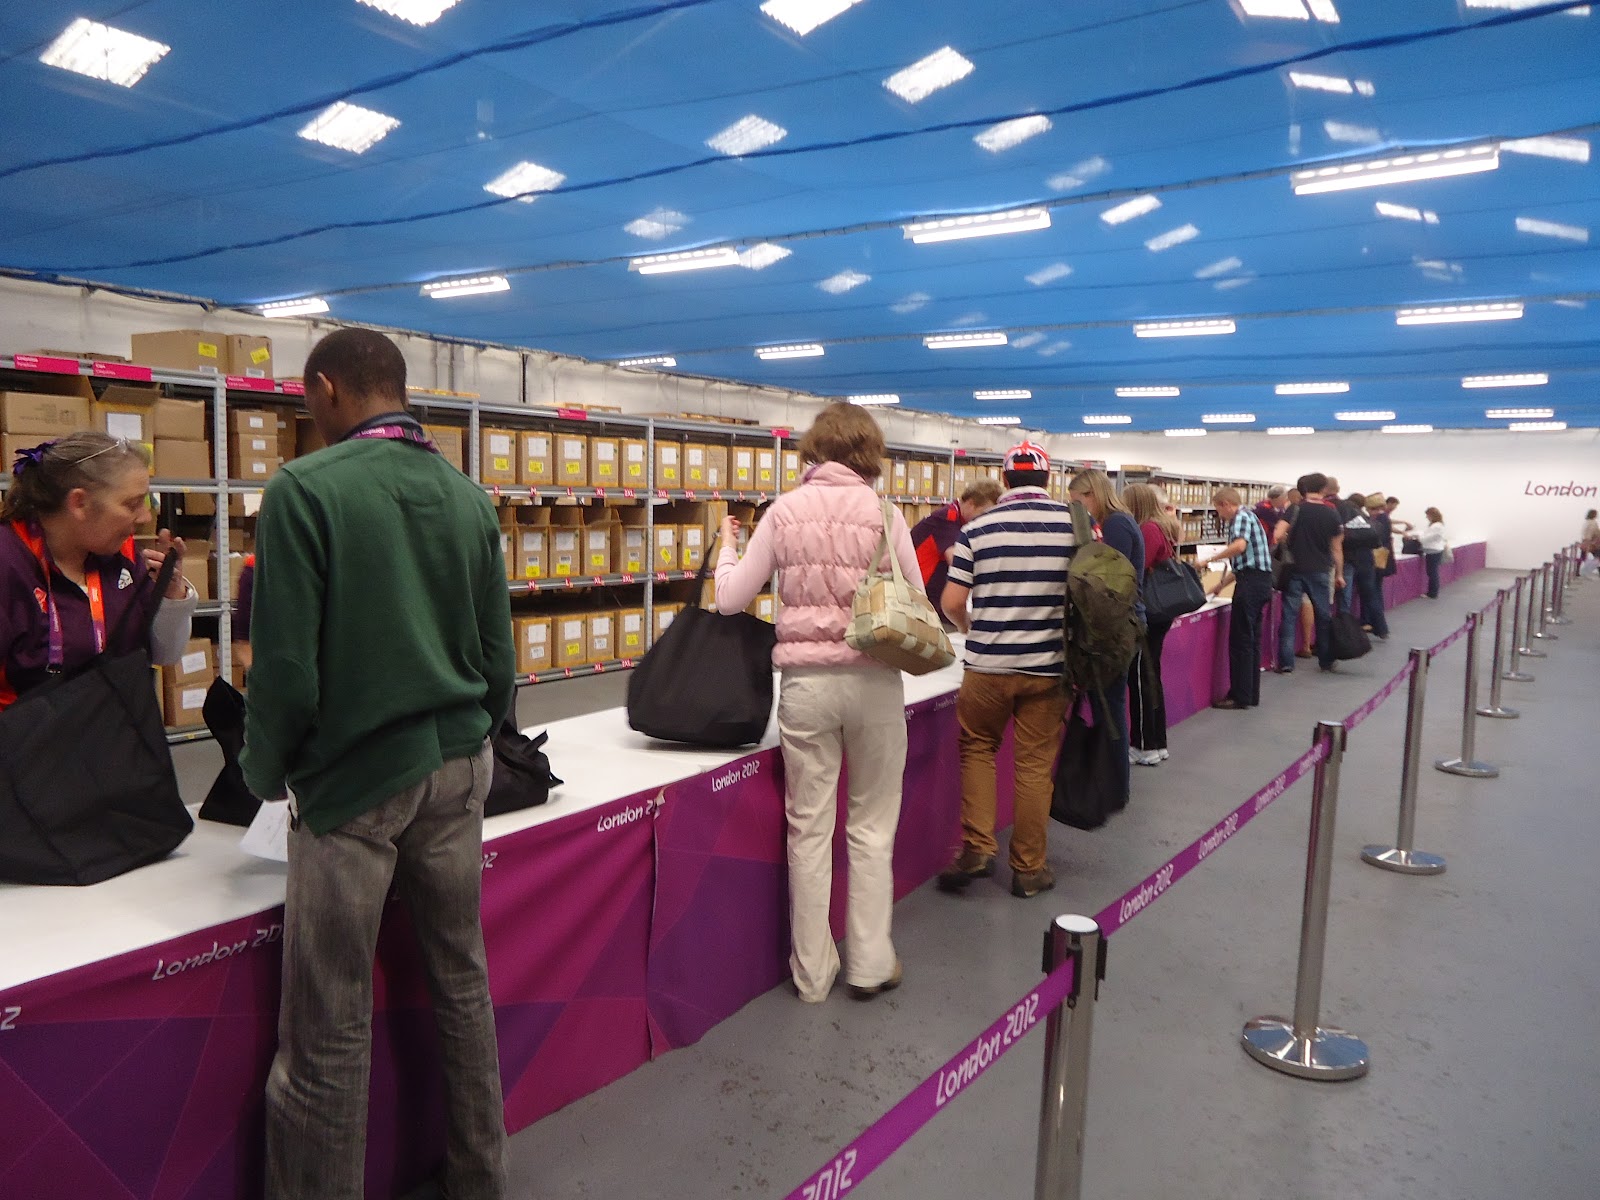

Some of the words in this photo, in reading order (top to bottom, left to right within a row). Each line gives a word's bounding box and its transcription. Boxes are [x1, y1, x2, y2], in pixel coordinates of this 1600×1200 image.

[1524, 480, 1598, 497] London
[712, 769, 741, 792] London
[741, 759, 760, 778] 2012
[597, 805, 643, 832] London
[481, 851, 498, 870] 12
[1119, 884, 1153, 923] London
[1153, 863, 1174, 895] 2012
[152, 940, 248, 980] London
[252, 924, 282, 948] 20
[936, 1031, 1001, 1107] London
[1003, 993, 1039, 1045] 2012
